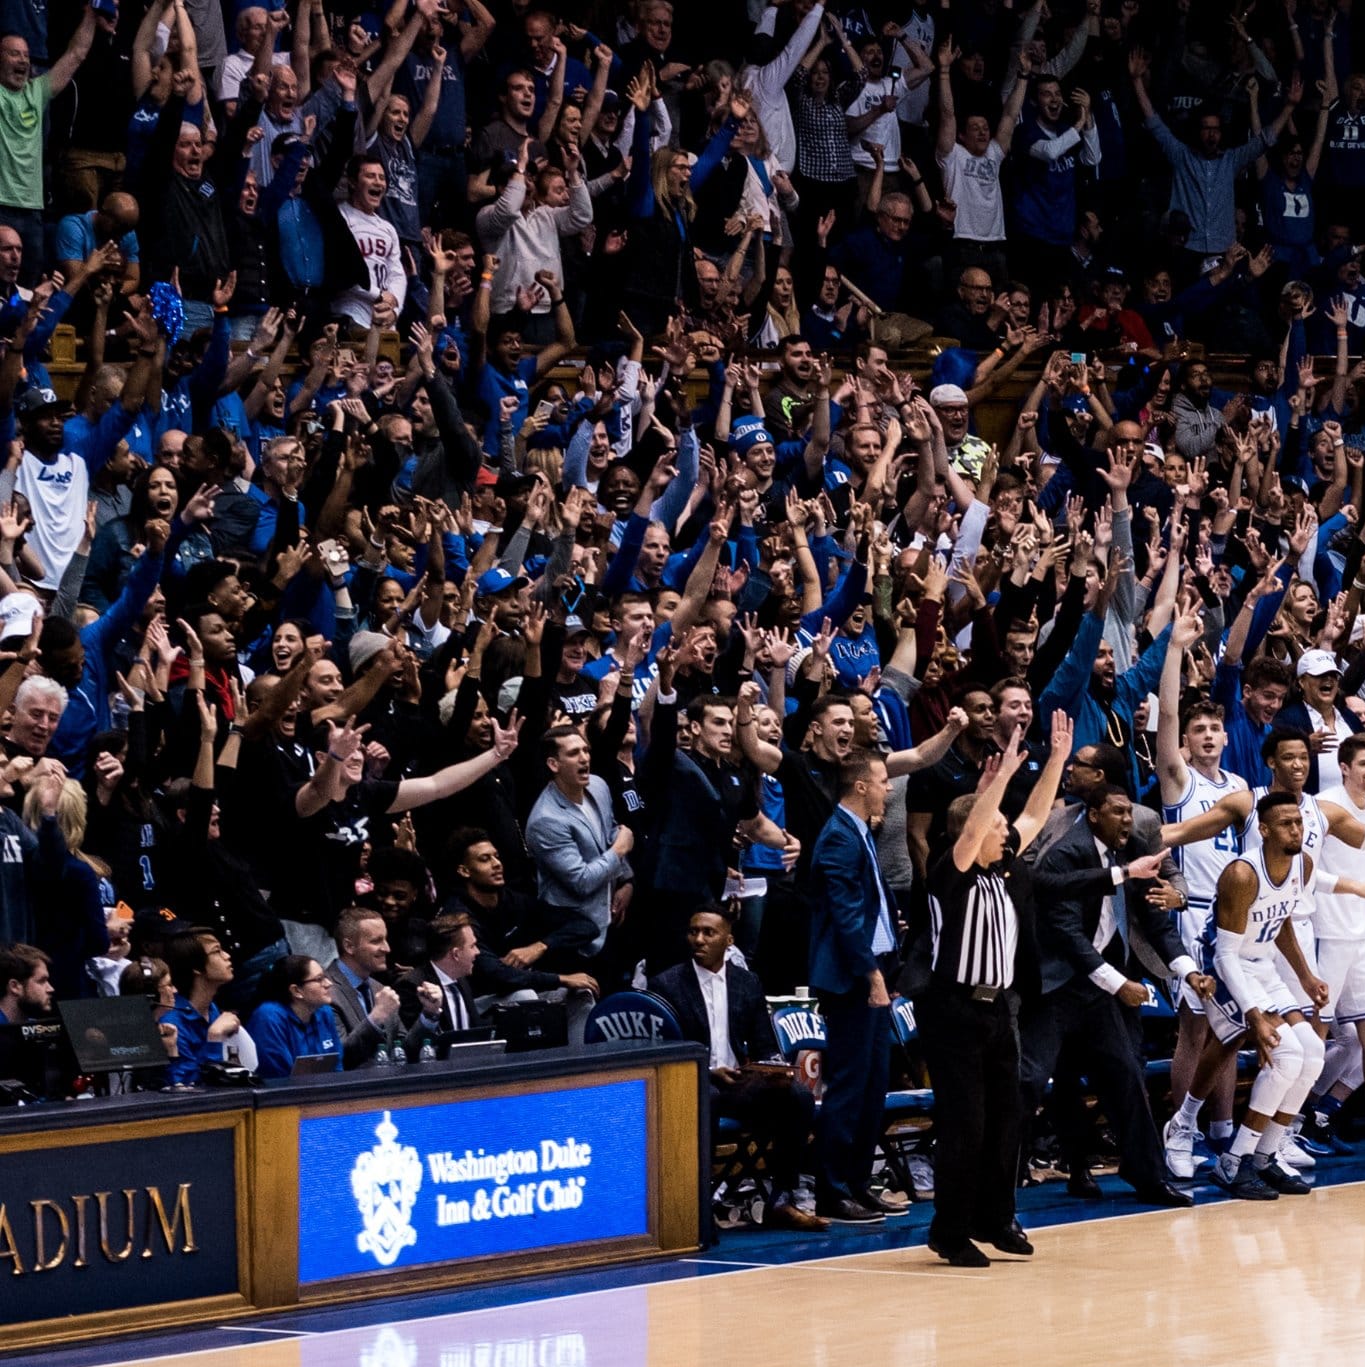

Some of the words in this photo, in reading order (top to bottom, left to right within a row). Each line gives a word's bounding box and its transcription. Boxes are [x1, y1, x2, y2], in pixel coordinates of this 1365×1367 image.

[595, 1011, 665, 1041] DUKE
[778, 1011, 827, 1046] DUKE
[428, 1149, 538, 1185] Washington
[541, 1138, 592, 1172] Duke
[437, 1195, 470, 1227] Inn
[472, 1189, 492, 1221] &
[491, 1183, 536, 1218] Golf
